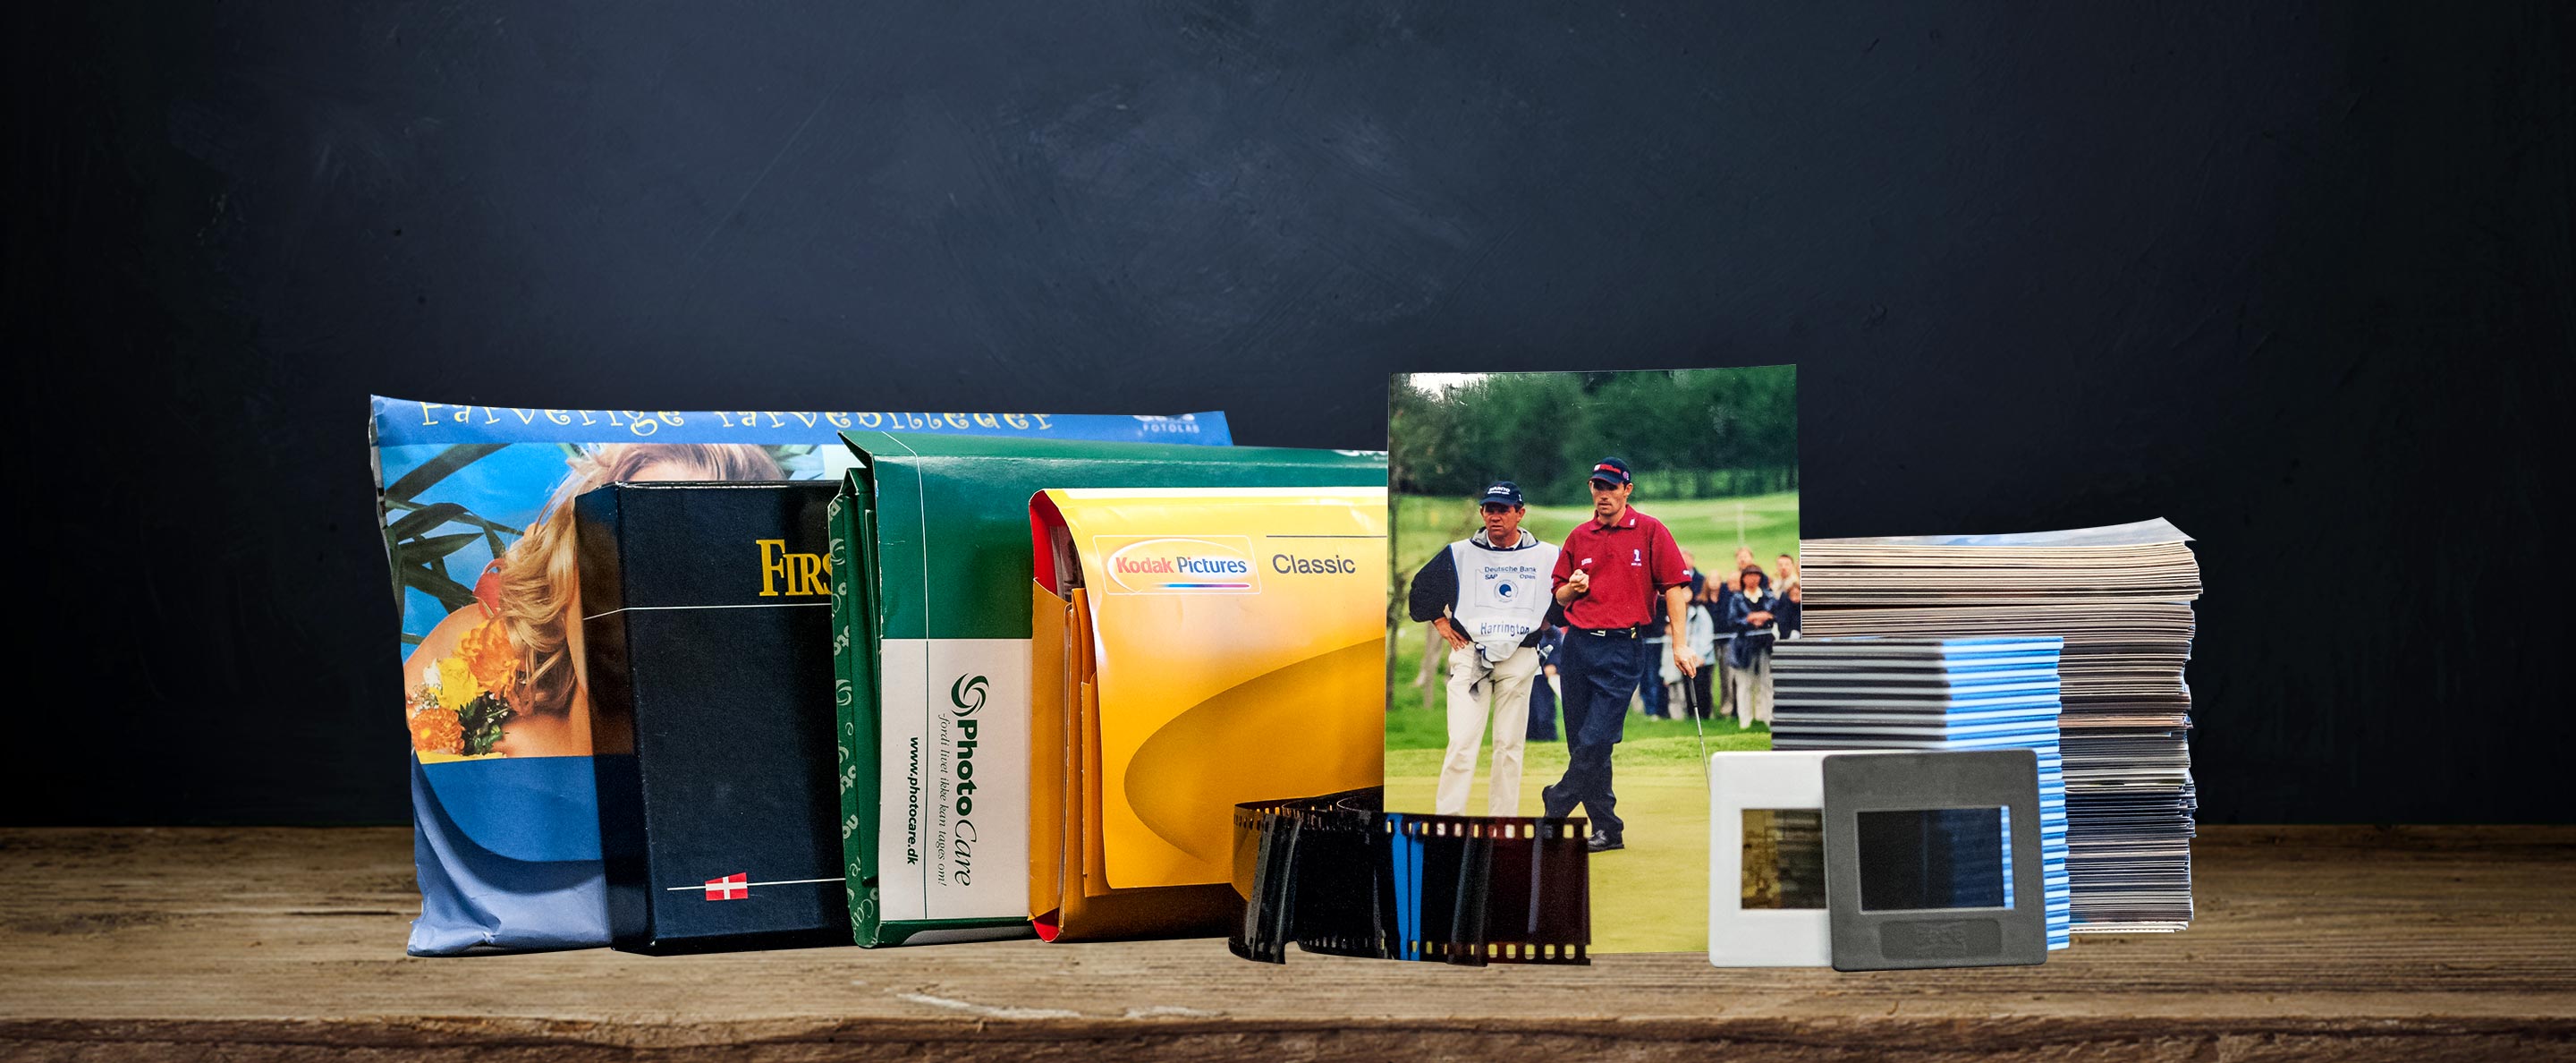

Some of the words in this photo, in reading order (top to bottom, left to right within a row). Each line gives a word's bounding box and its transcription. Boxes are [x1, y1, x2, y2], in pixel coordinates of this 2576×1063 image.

[1115, 556, 1174, 574] Kodak
[1176, 556, 1248, 574] Pictures
[1272, 554, 1357, 574] Classic
[1480, 622, 1530, 636] Harrington
[939, 748, 950, 774] livet
[907, 736, 920, 865] www.photocare.dk
[940, 777, 950, 802] ikke
[939, 804, 949, 827] kan
[936, 830, 947, 860] tages
[938, 863, 947, 887] om!
